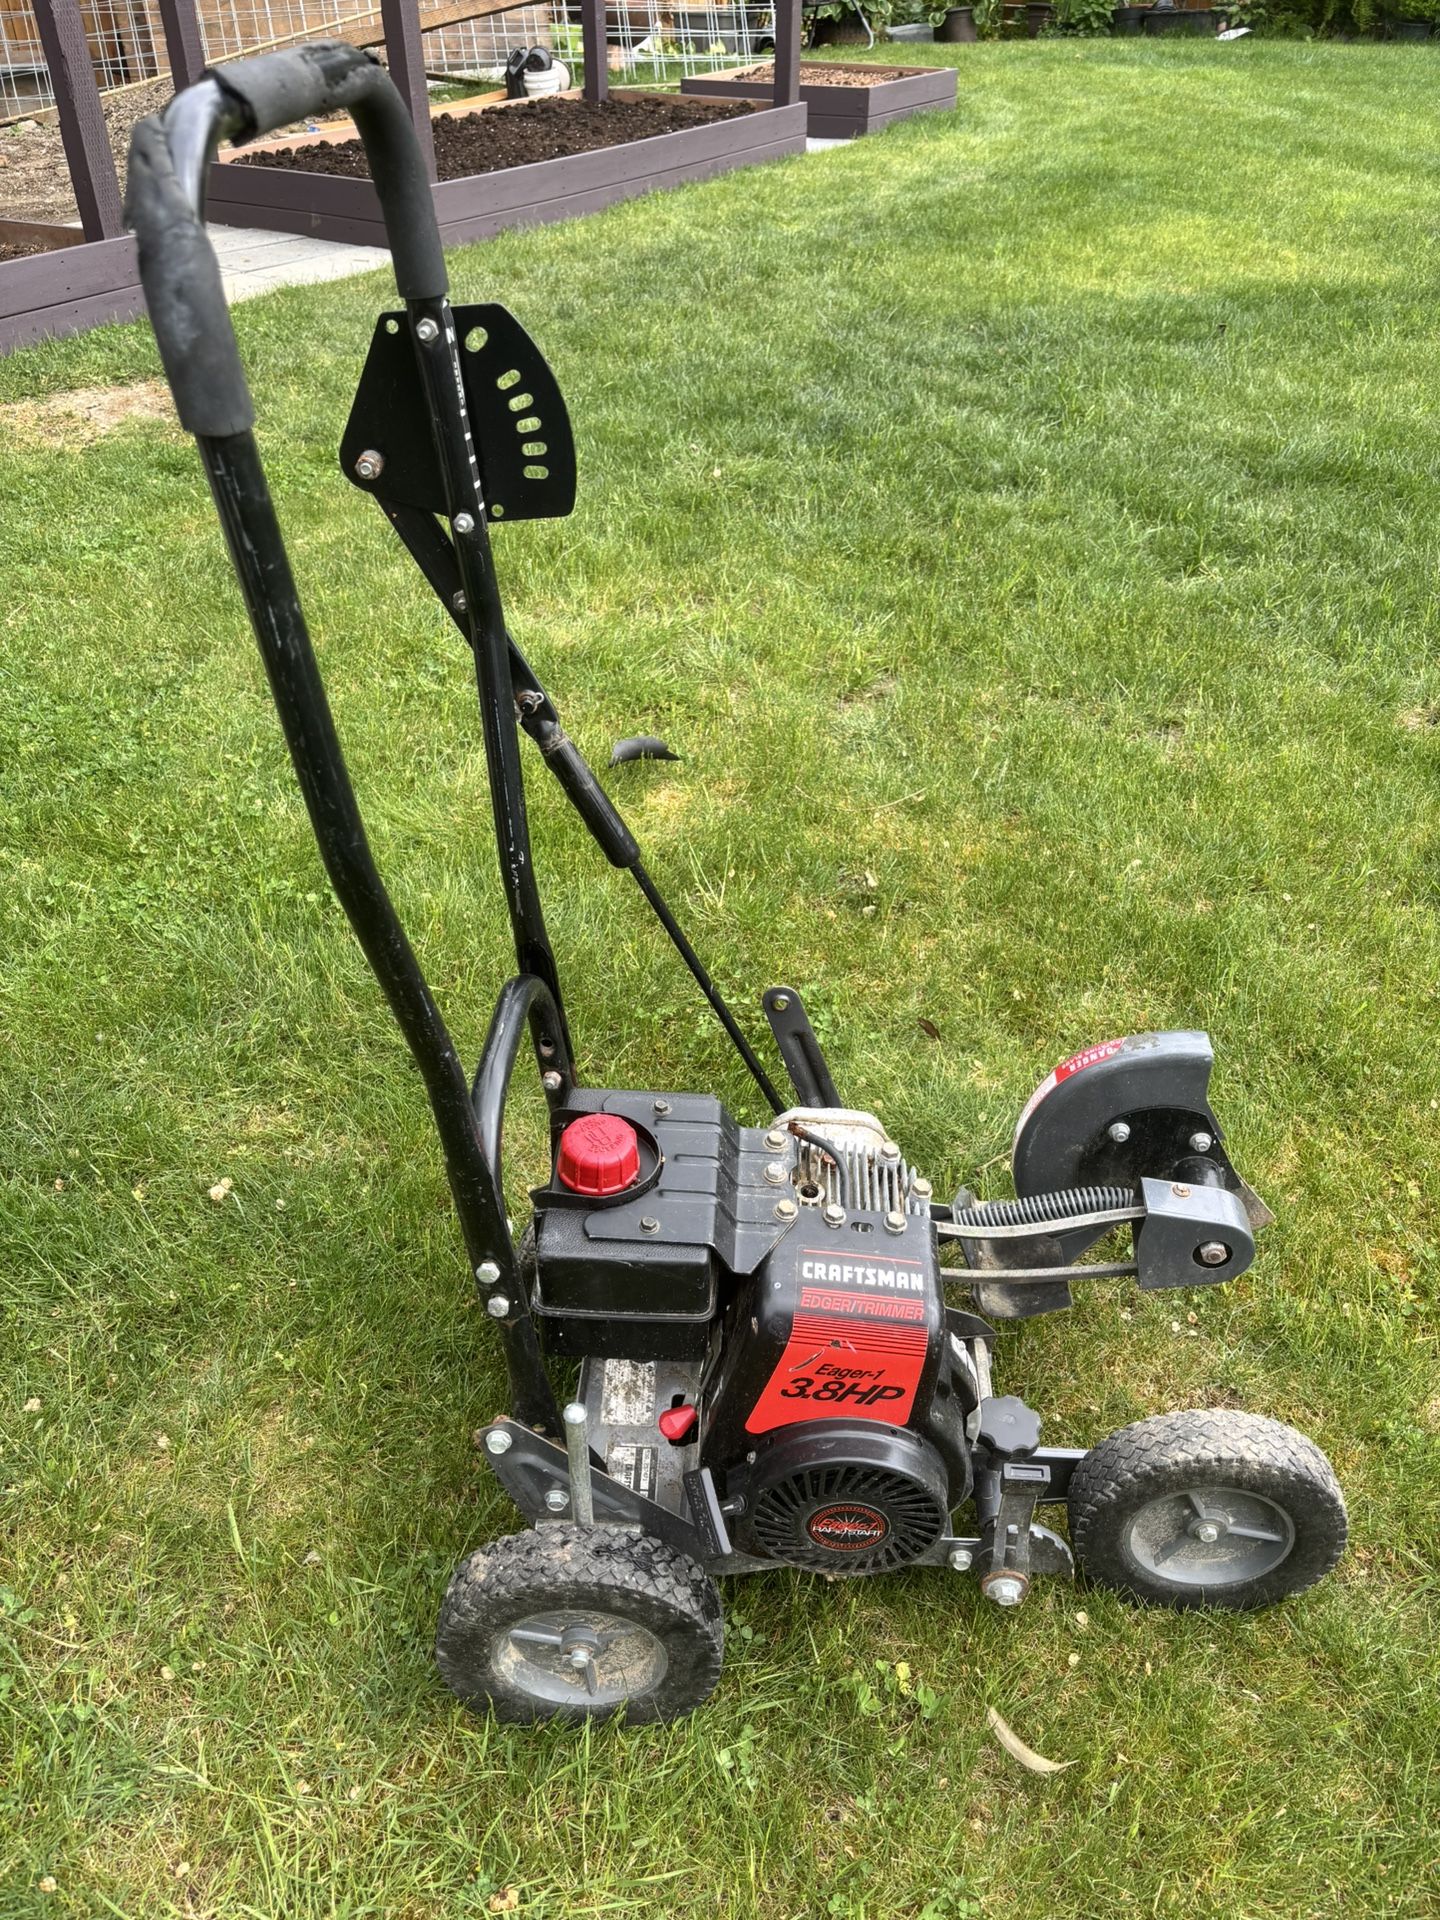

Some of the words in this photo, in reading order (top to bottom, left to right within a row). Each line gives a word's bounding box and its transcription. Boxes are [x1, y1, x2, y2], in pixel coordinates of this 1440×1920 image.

[1068, 1046, 1115, 1072] DANGER
[801, 1261, 924, 1290] CRAFTSMAN
[800, 1294, 924, 1321] EDGER/TRIMMER
[814, 1363, 886, 1381] Eager-1
[780, 1377, 906, 1405] 3.8HP
